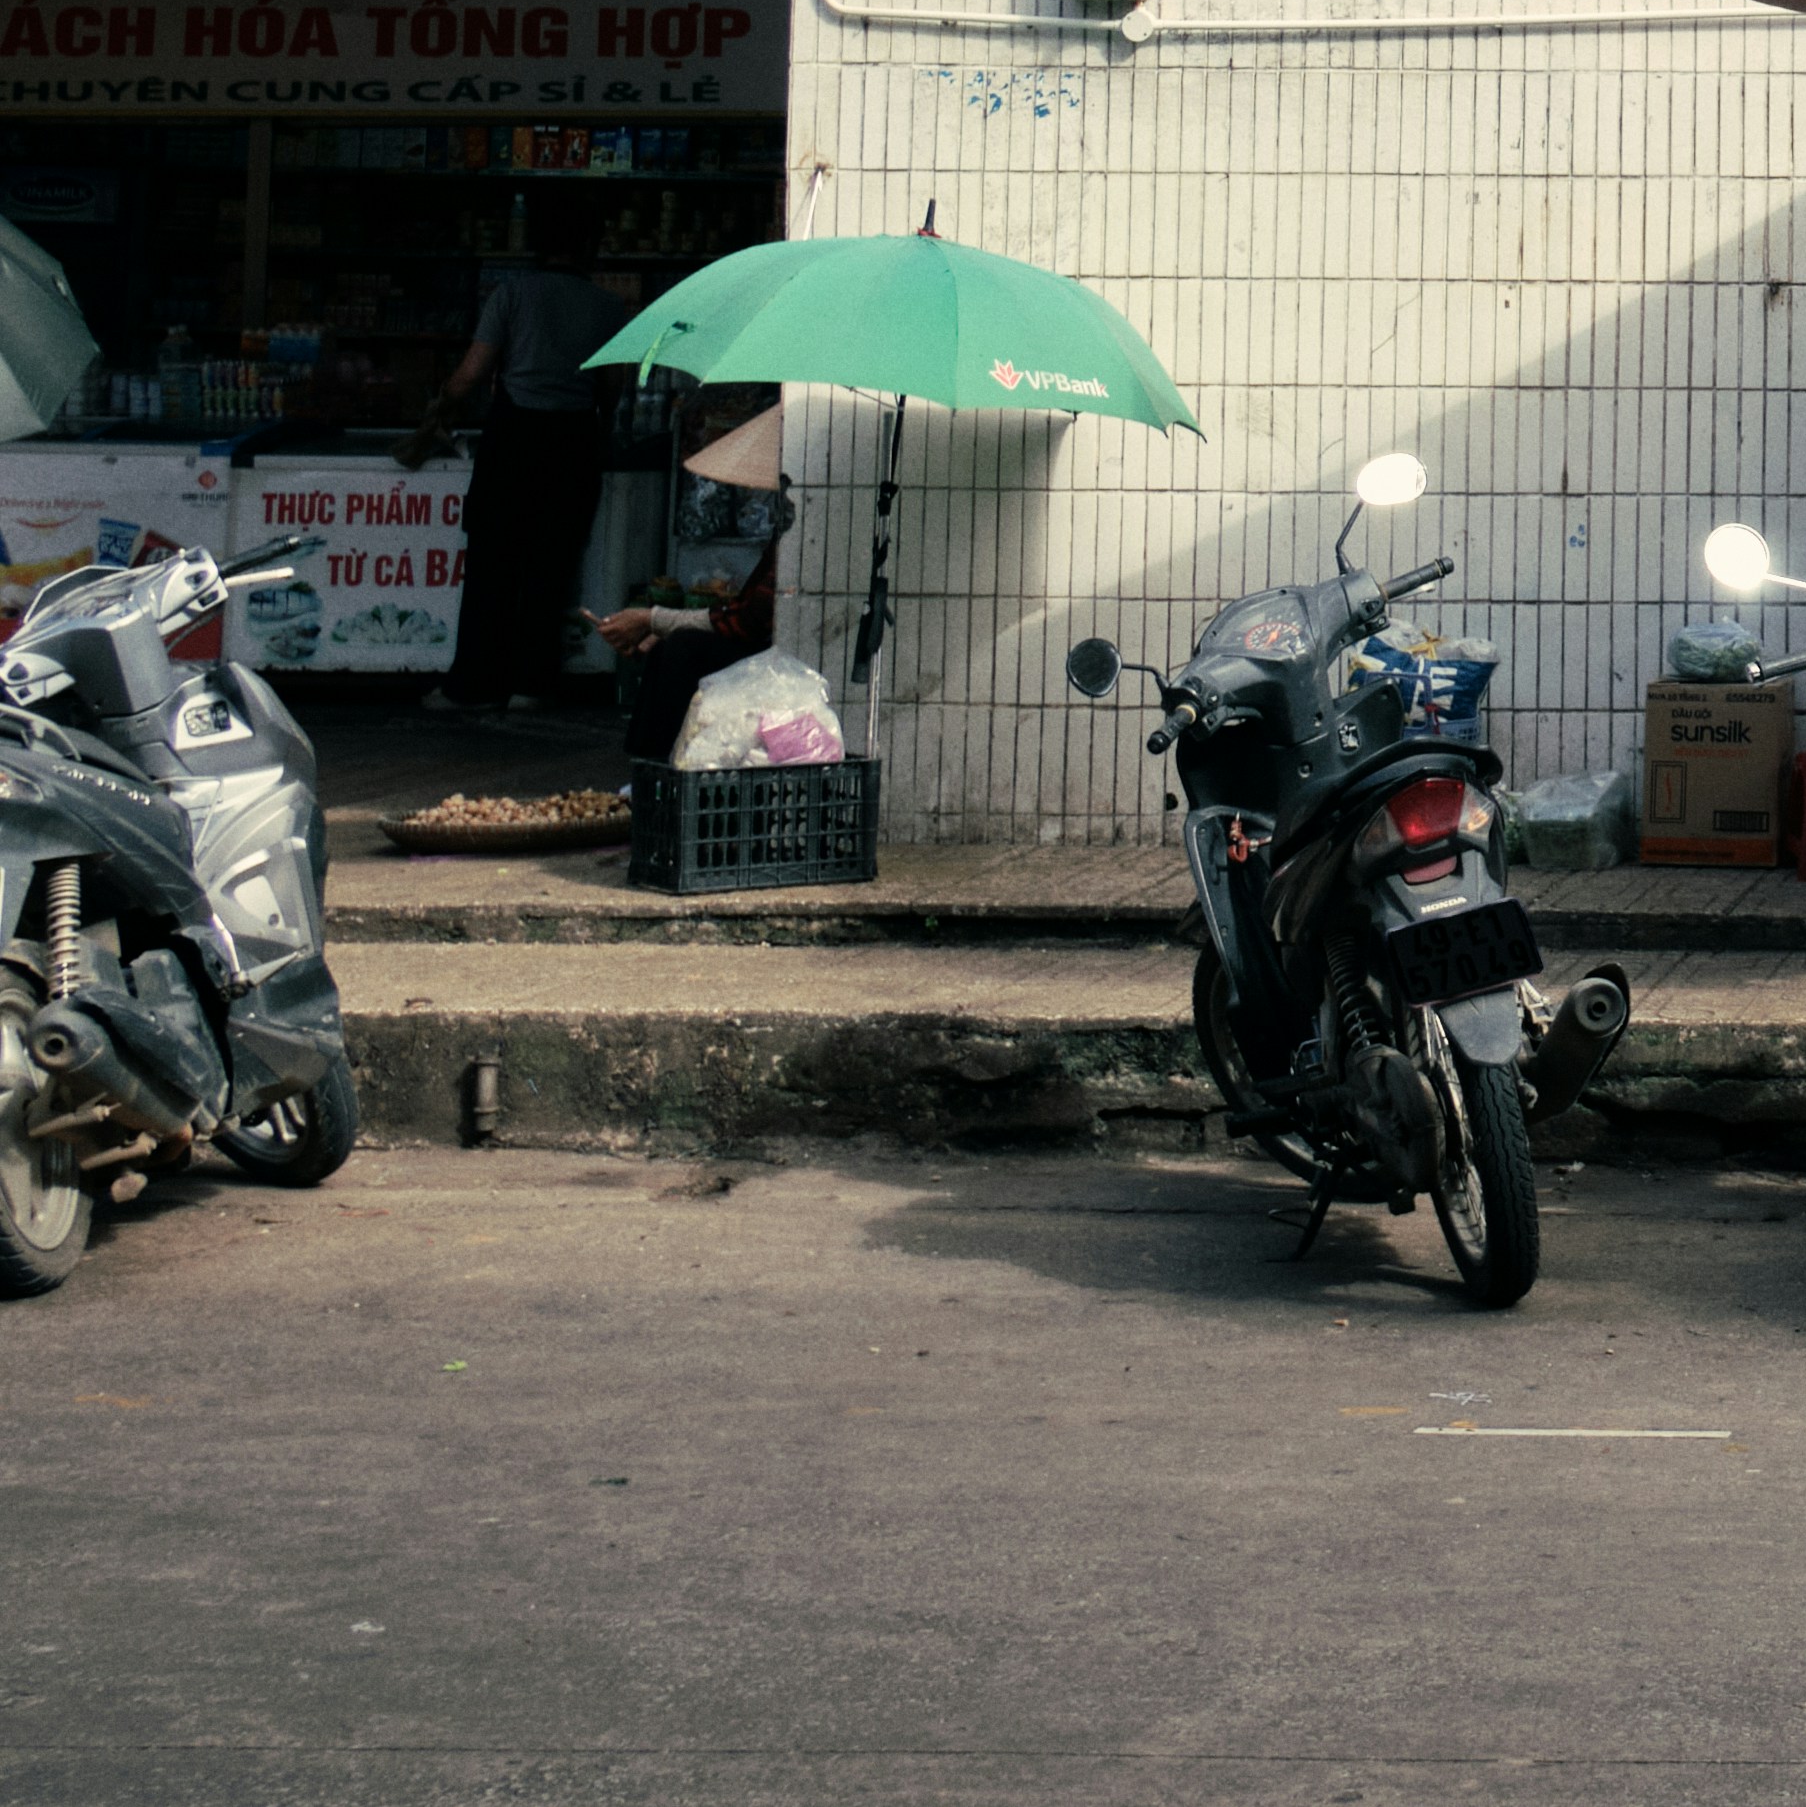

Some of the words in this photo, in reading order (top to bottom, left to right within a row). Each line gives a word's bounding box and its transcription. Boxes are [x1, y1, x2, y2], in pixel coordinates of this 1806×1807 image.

[598, 3, 752, 69] HỢP
[226, 81, 391, 102] CUNG
[407, 75, 522, 102] CẤP
[602, 80, 643, 102] &
[659, 75, 721, 102] LẺ
[1024, 369, 1109, 398] VPBank
[262, 491, 336, 533] THỰC
[346, 481, 430, 526] PHẨM
[327, 549, 370, 587] TỪ
[374, 549, 415, 587] CÁ
[1670, 720, 1752, 744] sunsilk
[1414, 910, 1505, 959] 49-E1
[1408, 940, 1532, 997] 570.49
